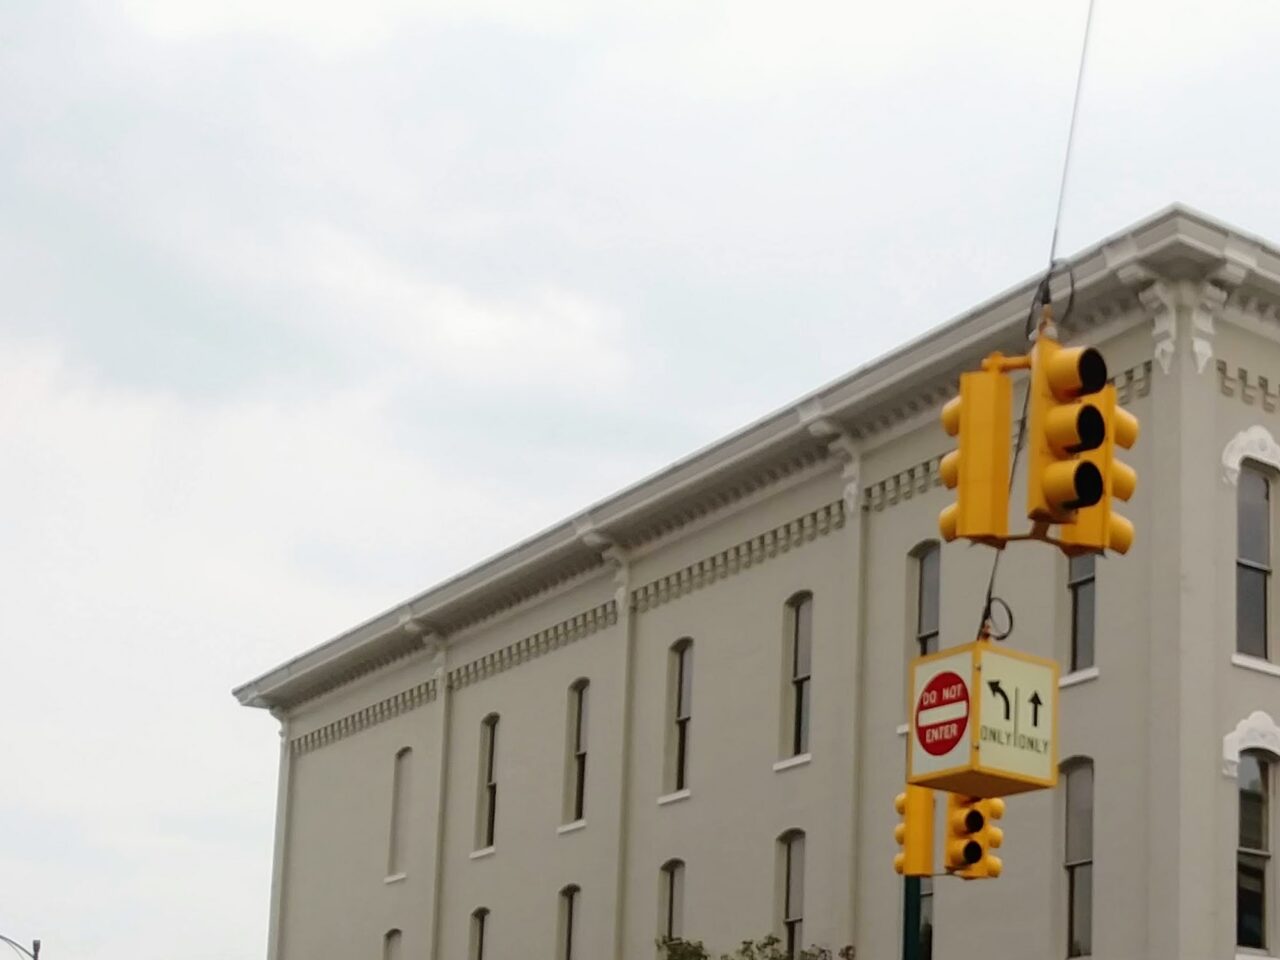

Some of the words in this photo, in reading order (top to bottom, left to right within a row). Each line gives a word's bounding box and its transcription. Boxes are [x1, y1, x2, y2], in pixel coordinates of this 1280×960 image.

[922, 690, 937, 706] DO
[942, 683, 963, 700] NOT
[925, 723, 958, 744] ENTER
[980, 724, 1011, 746] ONLY
[1018, 733, 1048, 756] ONLY
